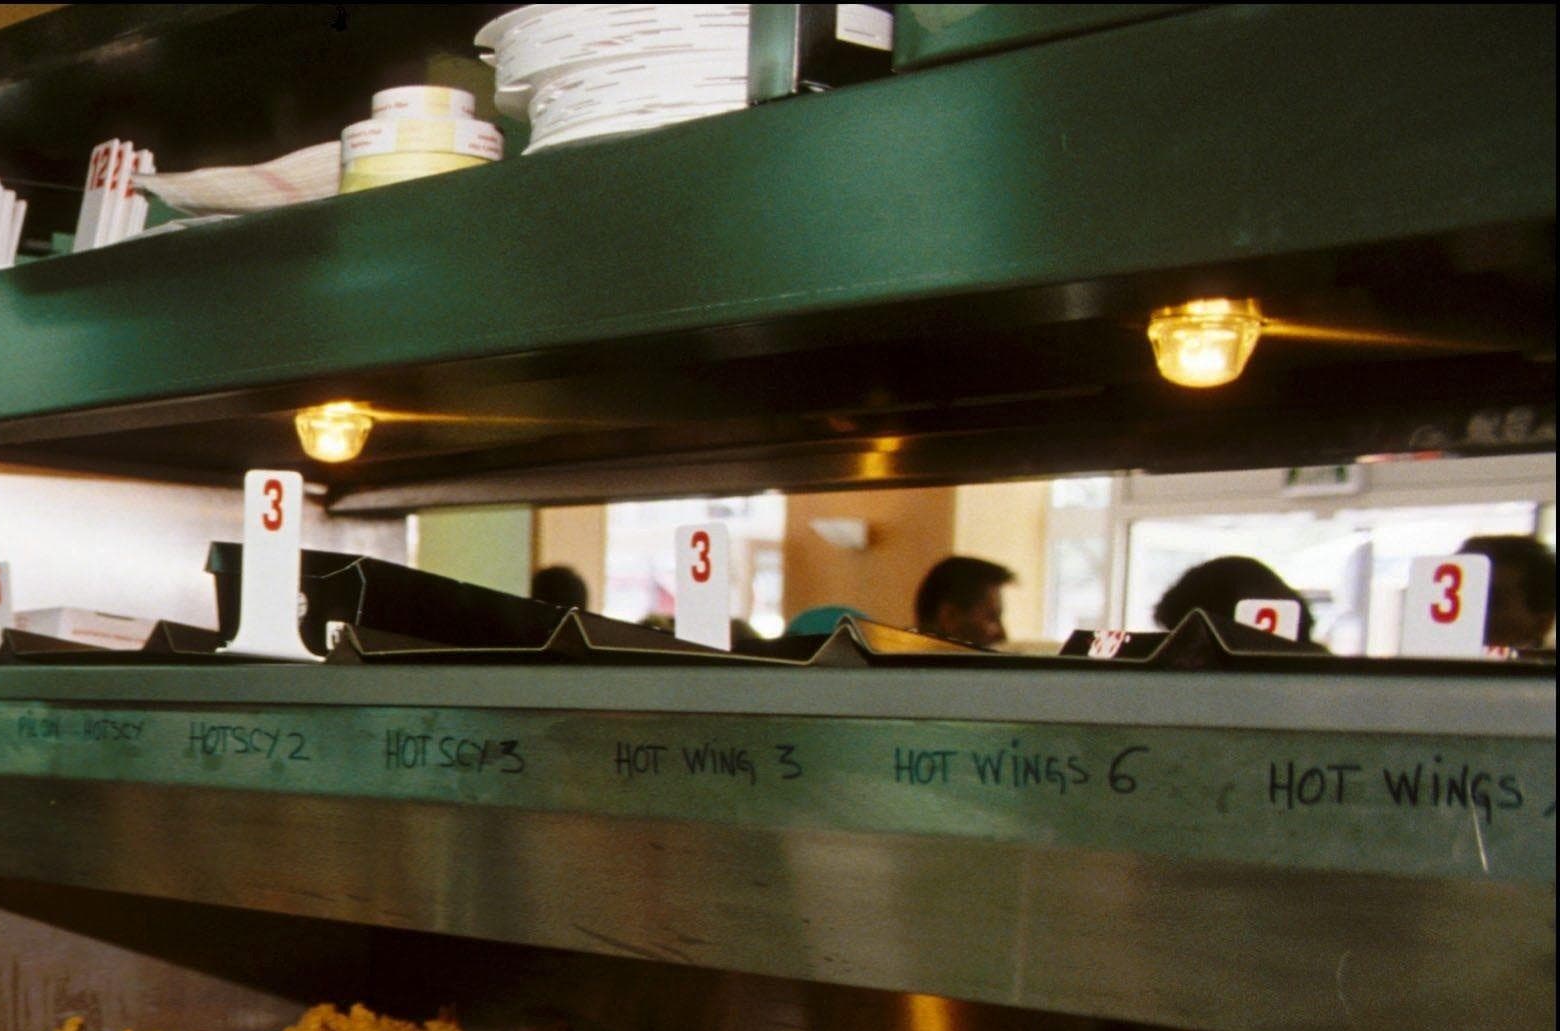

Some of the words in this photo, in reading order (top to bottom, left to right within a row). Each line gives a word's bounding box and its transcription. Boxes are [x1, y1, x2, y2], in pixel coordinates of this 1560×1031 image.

[90, 146, 111, 191] 12
[263, 479, 283, 531] 3
[691, 531, 711, 583] 3
[1430, 563, 1461, 623] 3
[287, 731, 311, 762] 2
[499, 739, 526, 775] 3
[614, 741, 668, 777] HOT
[775, 744, 803, 780] 3
[894, 746, 958, 786] HOT
[1108, 745, 1151, 794] 6
[1269, 759, 1361, 811] HOT
